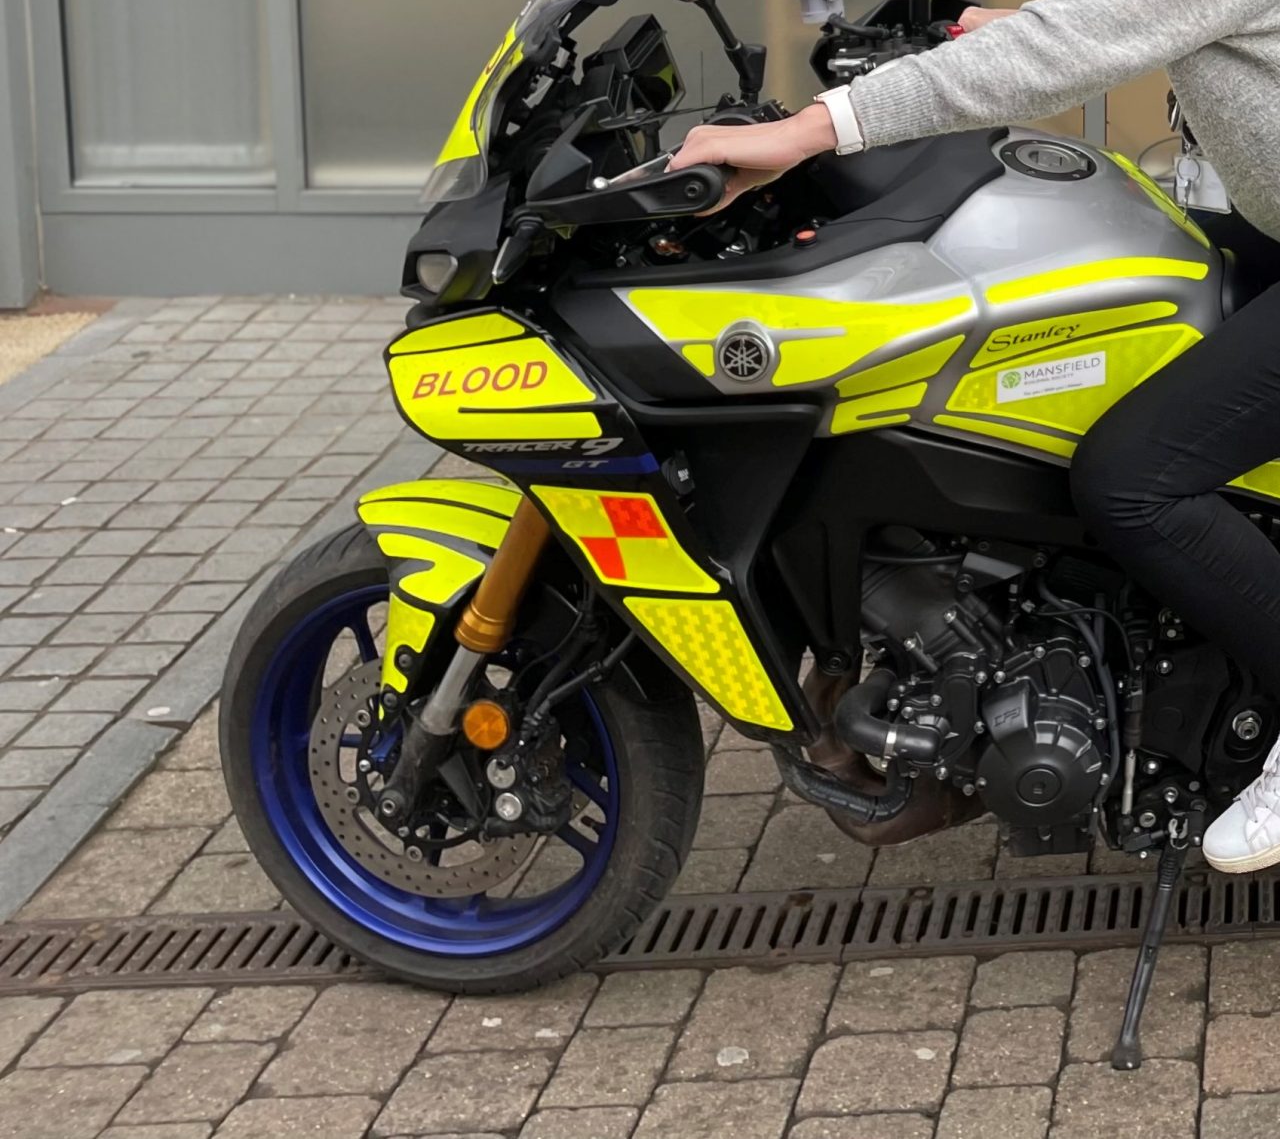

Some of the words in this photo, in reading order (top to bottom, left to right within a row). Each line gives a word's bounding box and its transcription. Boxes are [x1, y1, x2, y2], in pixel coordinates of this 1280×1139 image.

[986, 322, 1080, 352] Stanley
[1024, 357, 1101, 379] MANSFIELD
[412, 361, 548, 399] BLOOD
[462, 440, 574, 454] TRACER
[579, 437, 624, 456] 9
[561, 460, 609, 469] GT
